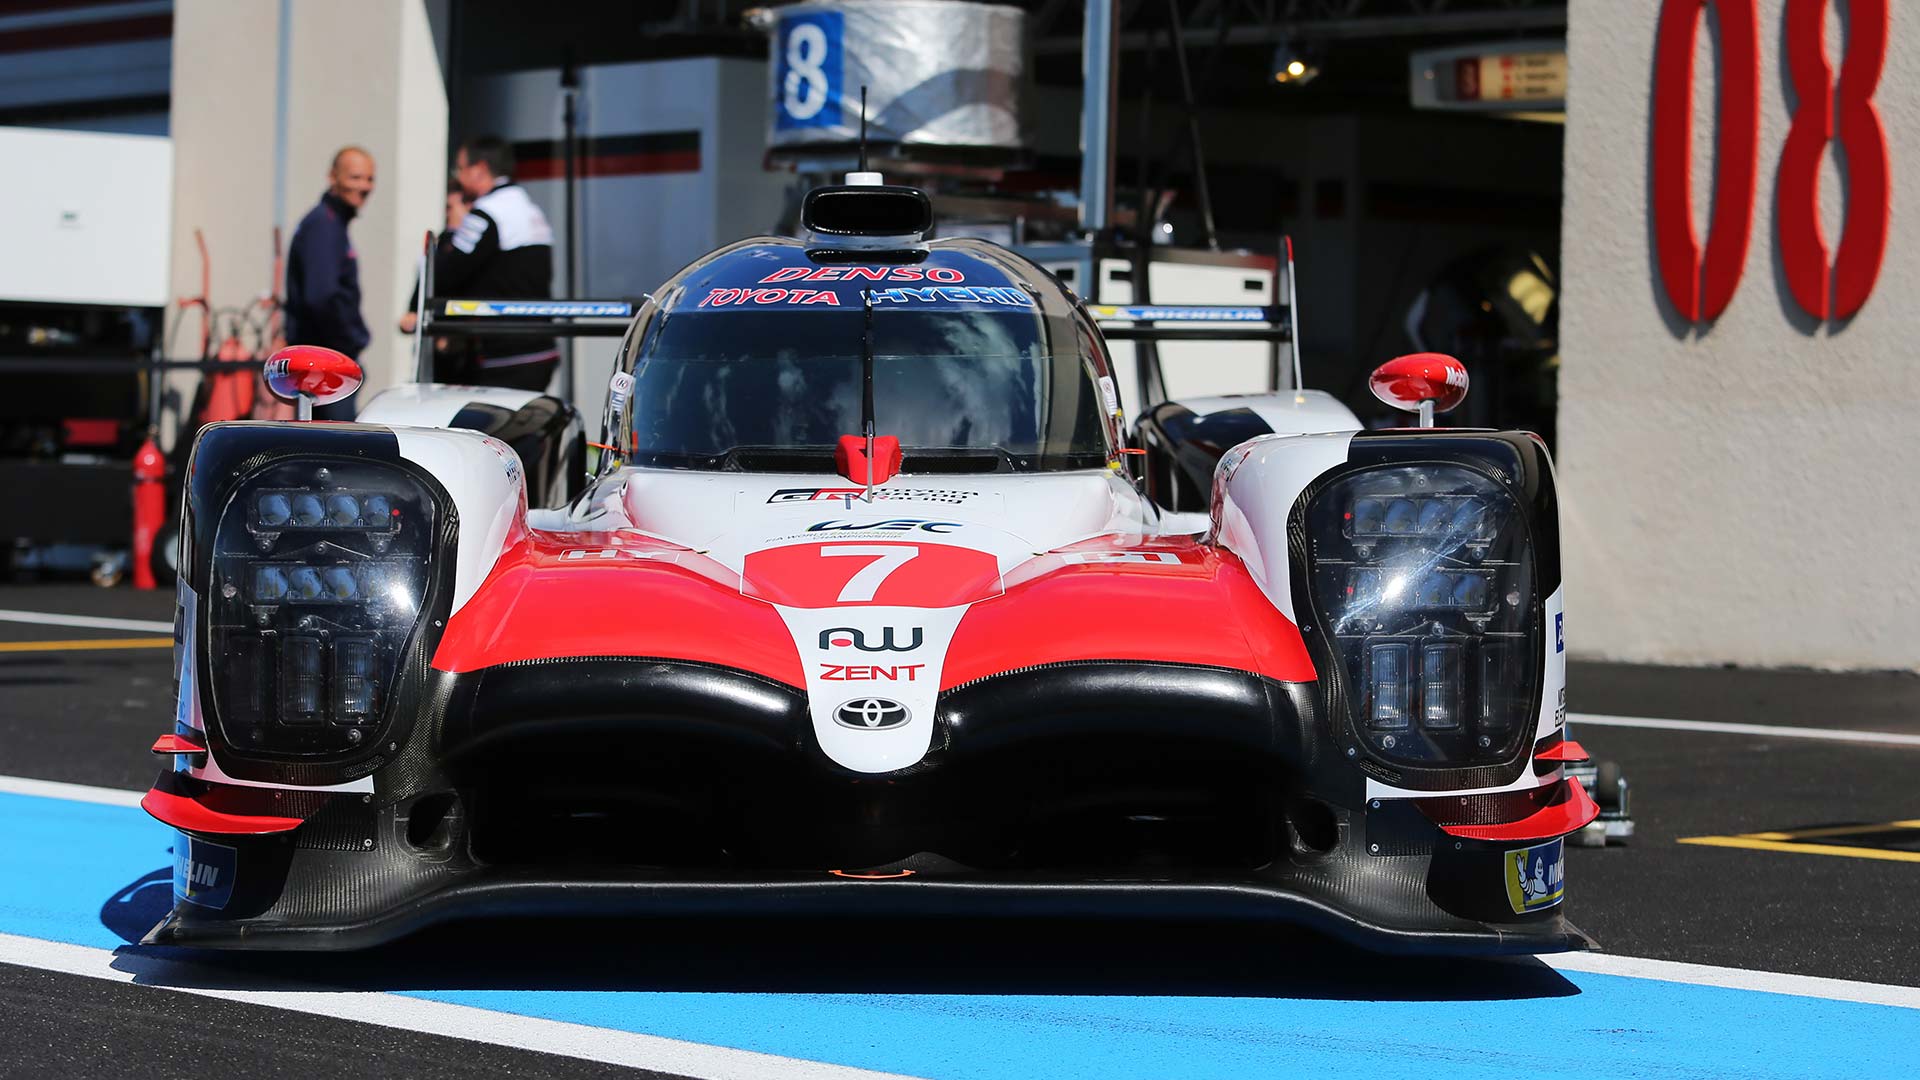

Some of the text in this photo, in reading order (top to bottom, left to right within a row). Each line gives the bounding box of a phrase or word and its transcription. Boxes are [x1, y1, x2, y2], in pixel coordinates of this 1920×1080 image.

[784, 23, 828, 120] 8
[1653, 0, 1891, 321] 08
[758, 266, 965, 284] DENSO
[698, 286, 1036, 308] TOYOTA HYBRID
[502, 304, 626, 315] MICHELIN
[1142, 310, 1265, 321] MICHELIN
[805, 519, 964, 534] WEC
[820, 545, 919, 602] 7
[820, 663, 925, 682] ZENT
